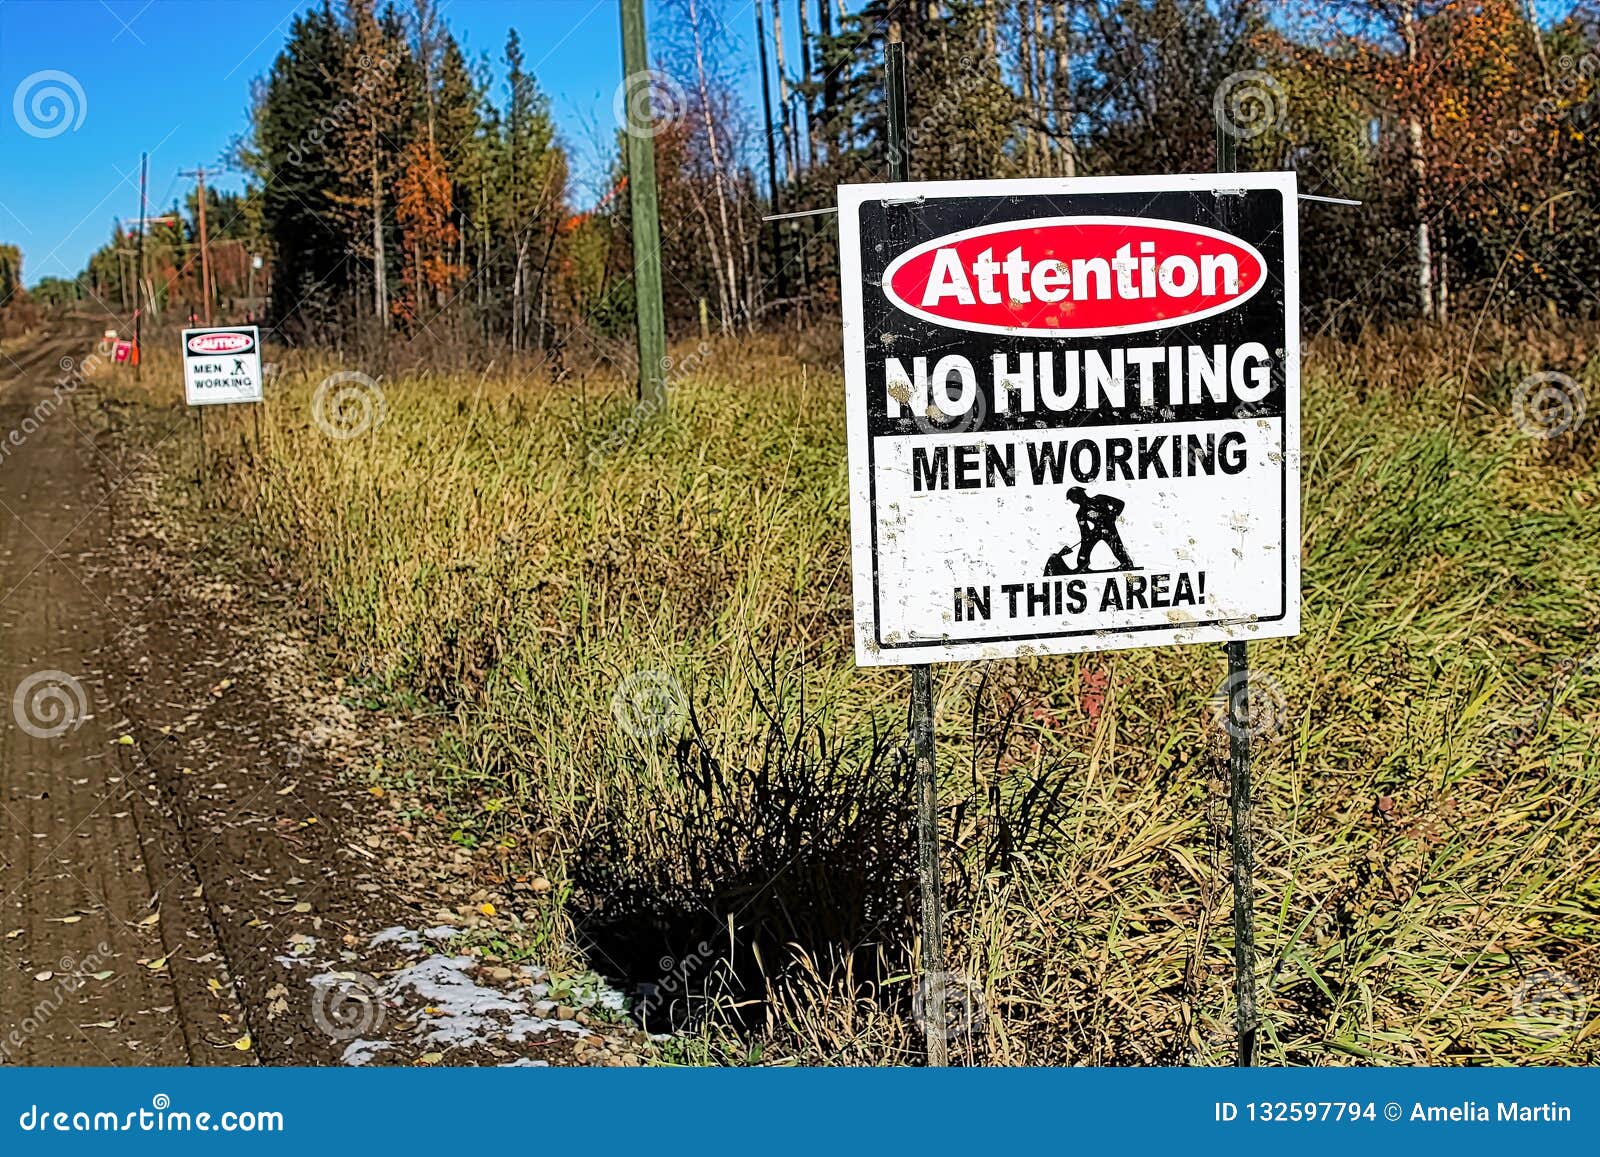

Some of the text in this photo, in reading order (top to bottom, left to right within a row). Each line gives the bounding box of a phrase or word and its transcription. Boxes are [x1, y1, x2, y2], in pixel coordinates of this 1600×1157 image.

[921, 241, 1239, 307] Attention
[192, 336, 247, 351] CAUTION
[193, 364, 222, 373] MEN
[194, 377, 252, 389] WORKING
[885, 354, 977, 418] NO
[993, 341, 1271, 414] HUNTING
[912, 431, 1247, 492] MEN WORKING
[953, 571, 1206, 622] IN THIS AREA!
